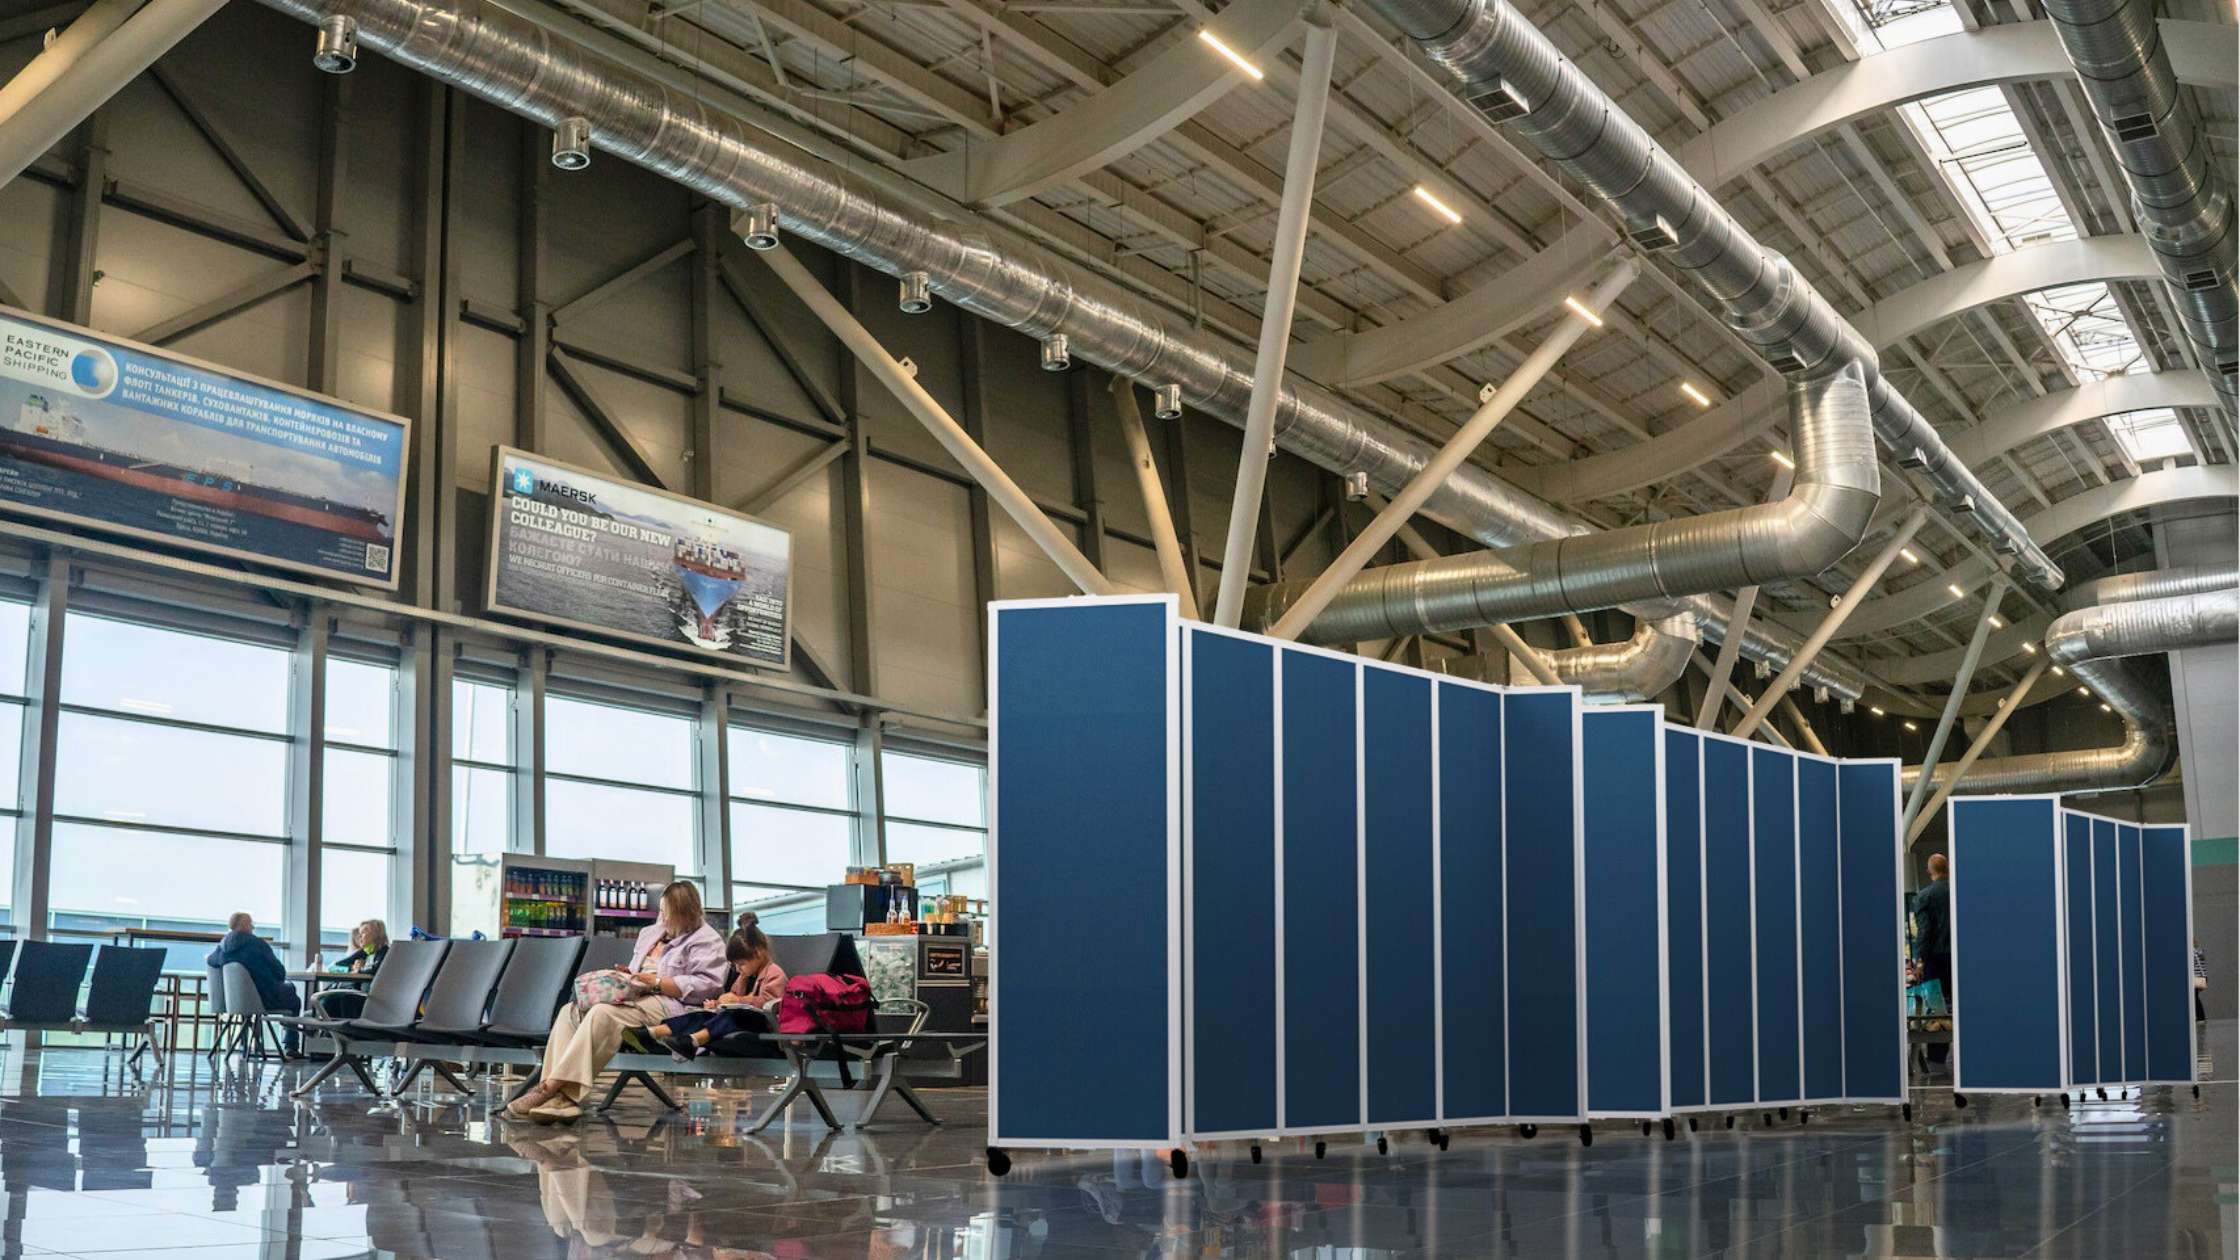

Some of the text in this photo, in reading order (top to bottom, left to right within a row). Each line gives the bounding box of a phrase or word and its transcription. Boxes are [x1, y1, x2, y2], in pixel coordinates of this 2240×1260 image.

[5, 346, 58, 367] PACIFIC
[7, 334, 69, 358] EASTERN
[3, 357, 68, 380] SHIPPING
[125, 362, 190, 388] КОНСУЛЬТАЦІЇ
[200, 383, 292, 415] ПРАЦЕВЛАШТУВАННЯ
[332, 420, 344, 430] НА
[225, 416, 244, 428] ДЛЯ
[540, 480, 597, 504] MAERSK
[511, 511, 597, 542] COLLEAGUE?
[512, 496, 671, 547] COULD YOU BE OUR NEW
